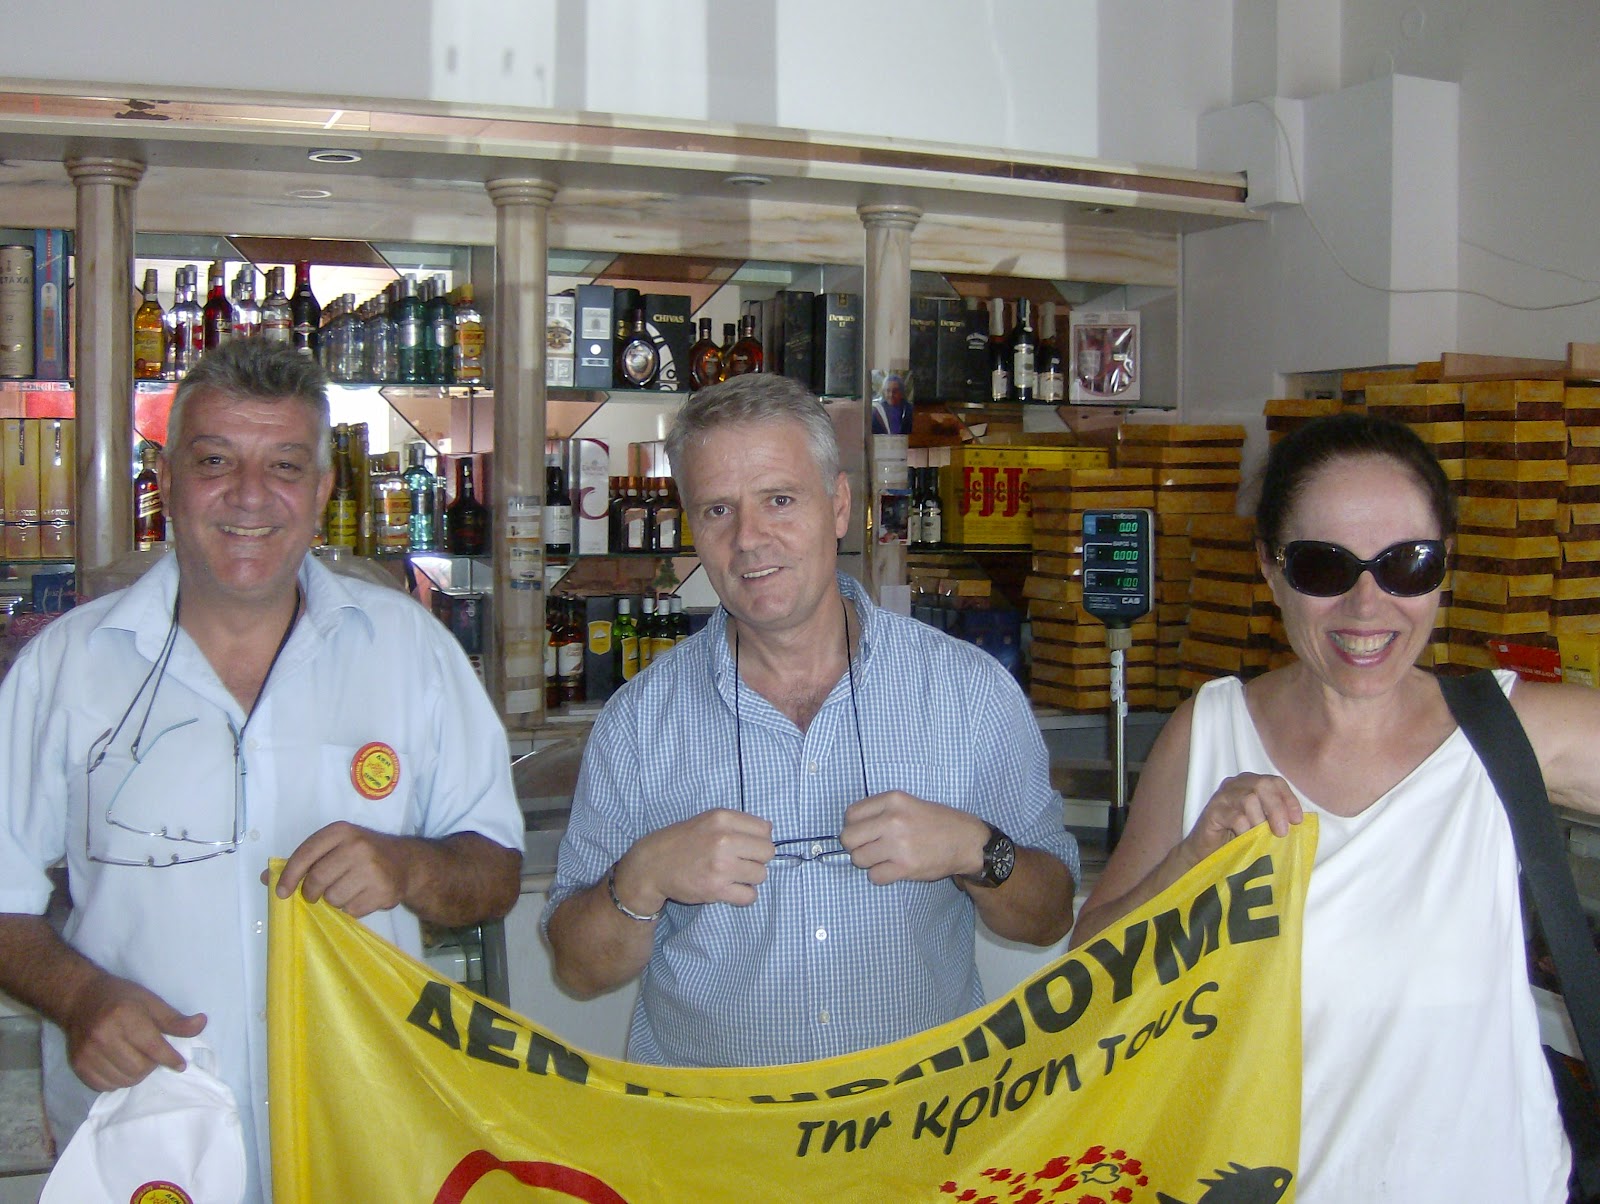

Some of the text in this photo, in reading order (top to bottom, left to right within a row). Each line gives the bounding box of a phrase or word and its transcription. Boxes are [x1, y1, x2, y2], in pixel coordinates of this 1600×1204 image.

[652, 313, 685, 324] CHIVAS
[1121, 597, 1141, 605] CAS
[406, 980, 589, 1085] ΔΕΝ
[911, 1052, 1082, 1156] κρίση
[1097, 981, 1220, 1077] τους
